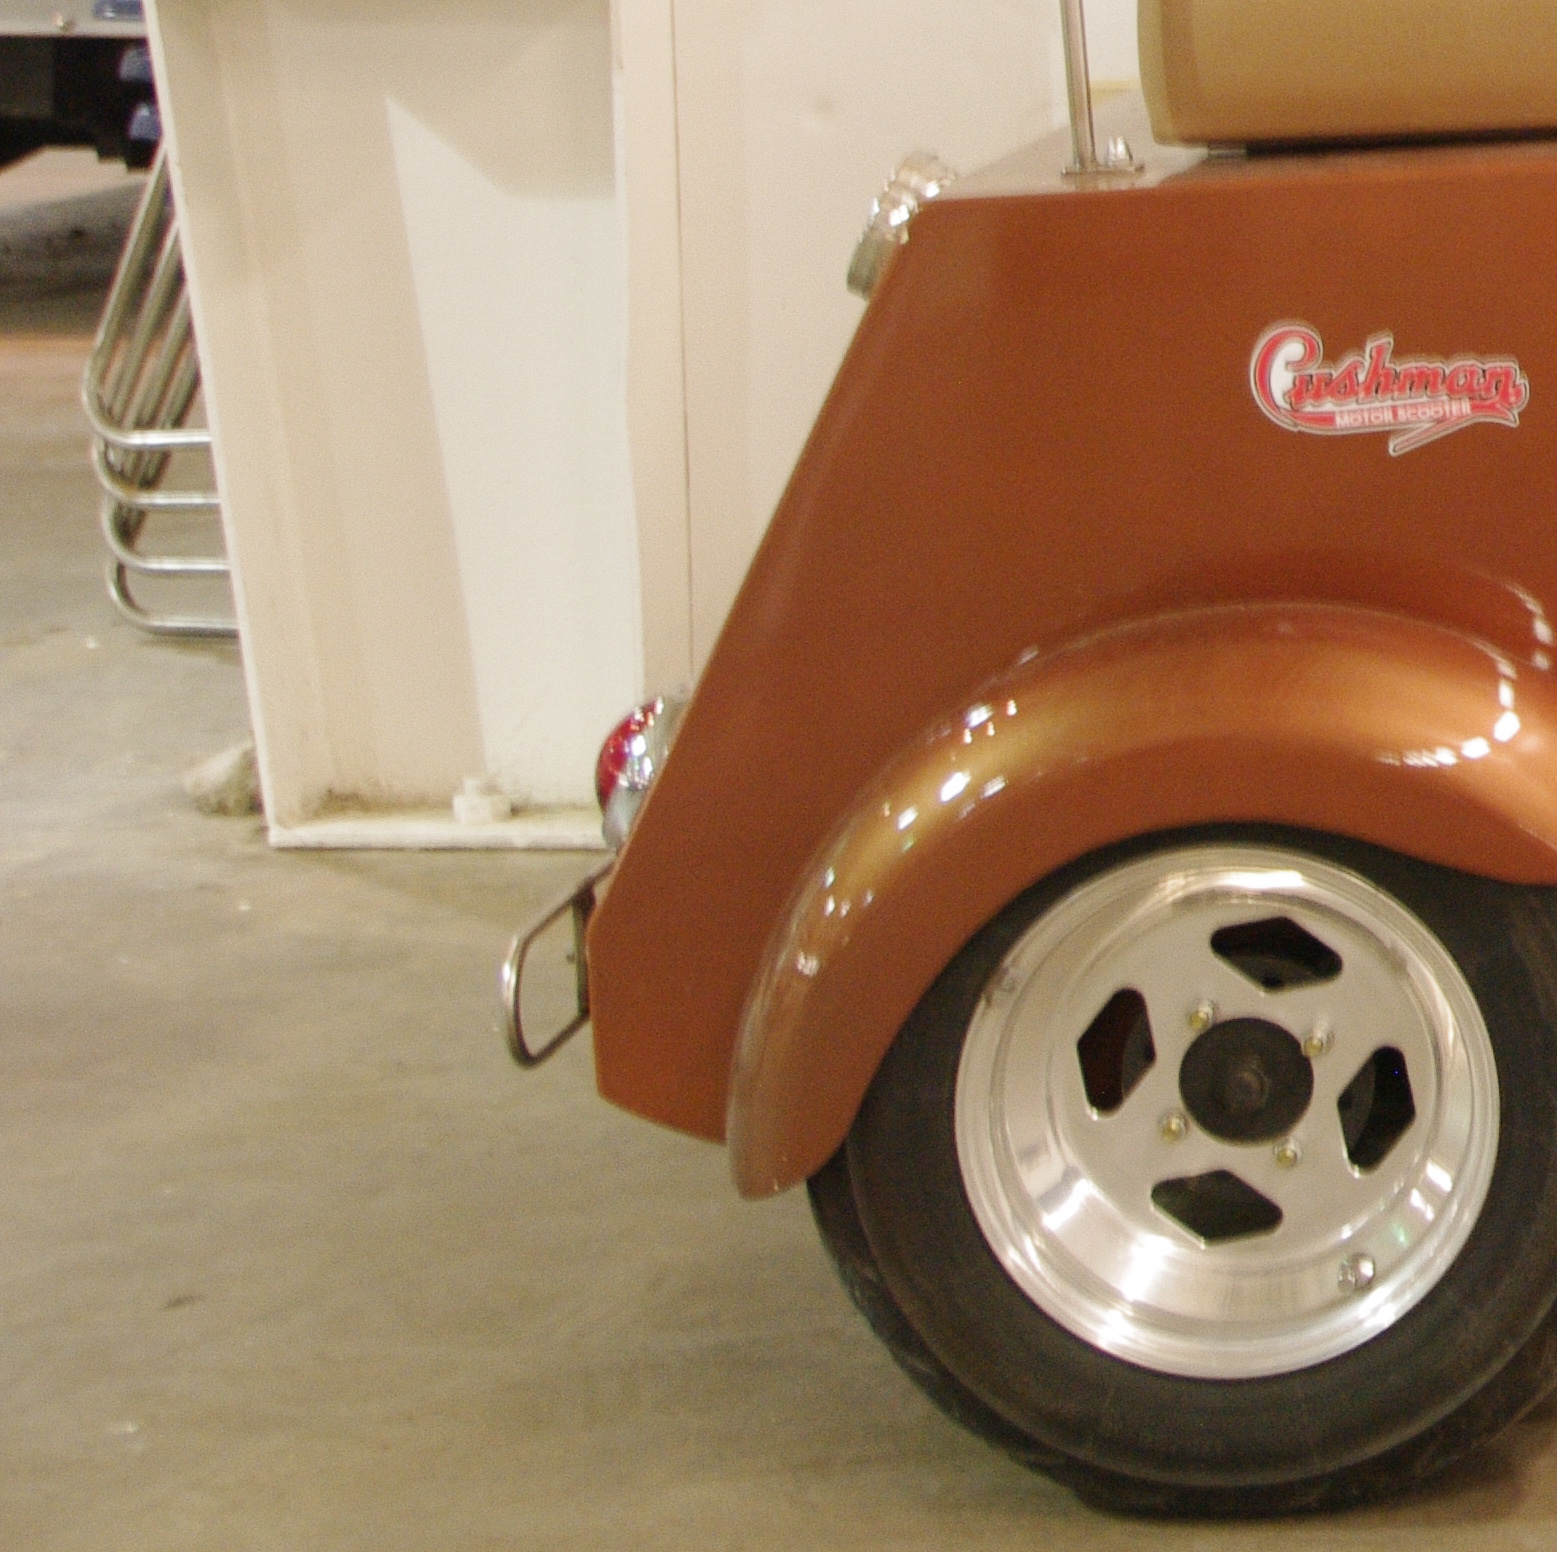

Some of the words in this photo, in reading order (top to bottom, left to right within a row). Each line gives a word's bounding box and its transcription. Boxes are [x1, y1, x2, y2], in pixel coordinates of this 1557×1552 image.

[1253, 324, 1526, 423] Cushman
[1335, 406, 1394, 428] MOTOR
[1397, 396, 1472, 425] SCOOTER
